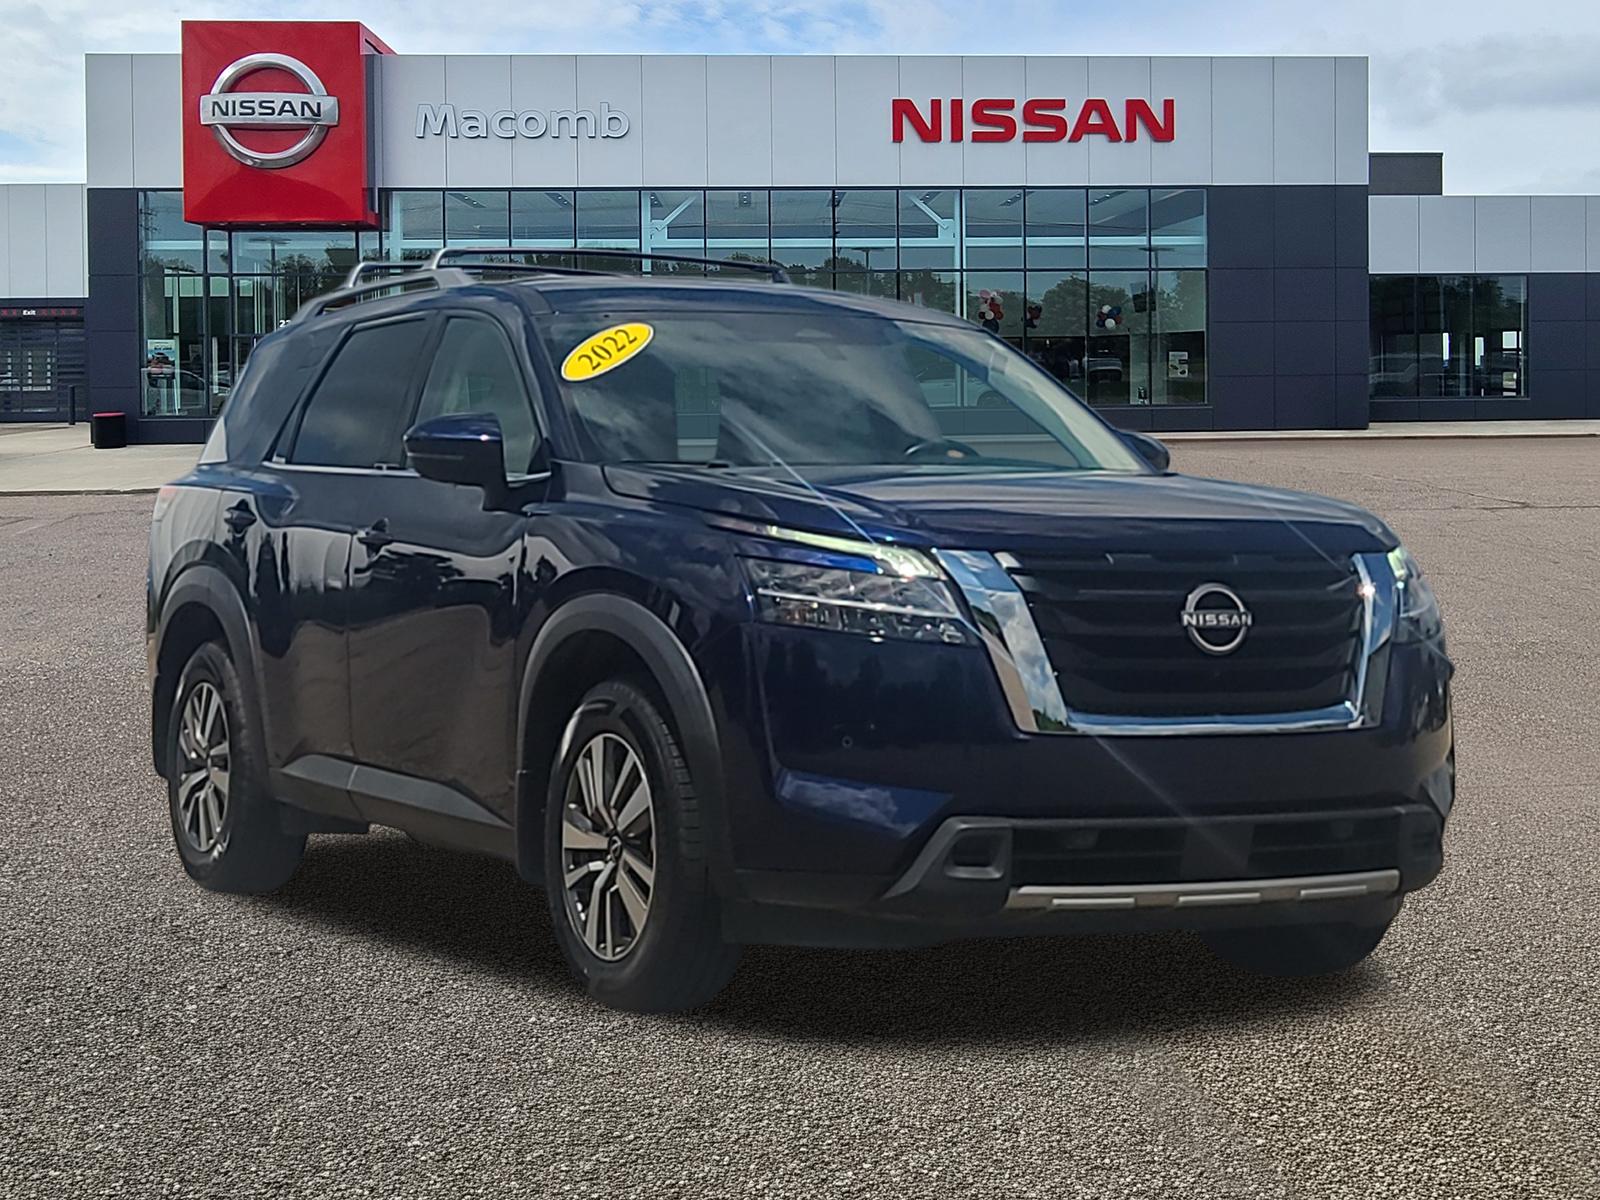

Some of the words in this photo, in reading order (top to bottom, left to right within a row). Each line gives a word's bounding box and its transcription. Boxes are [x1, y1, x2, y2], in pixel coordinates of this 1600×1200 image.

[212, 100, 322, 118] NISSAN
[415, 102, 630, 138] Macomb
[892, 98, 1174, 142] NISSAN
[577, 328, 638, 371] 2022
[1183, 613, 1252, 627] NISSAN
